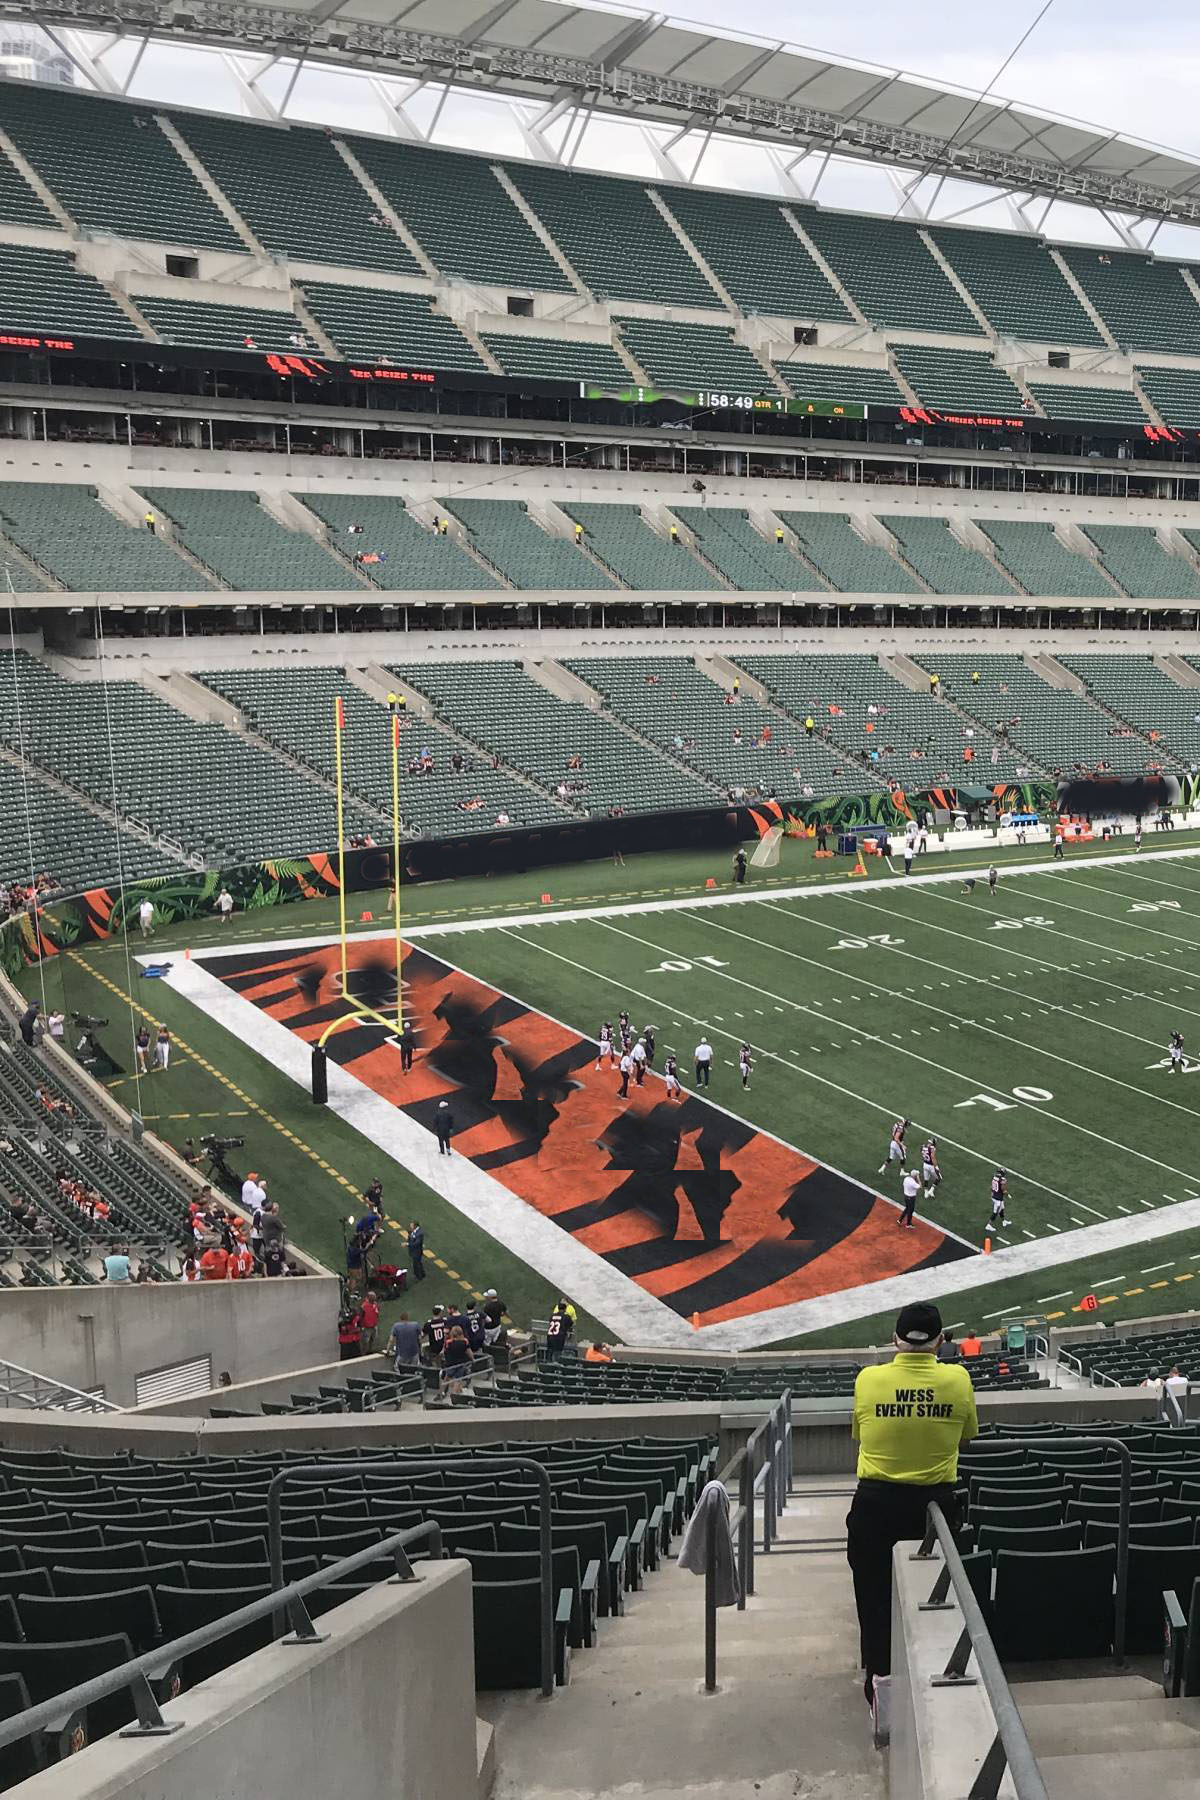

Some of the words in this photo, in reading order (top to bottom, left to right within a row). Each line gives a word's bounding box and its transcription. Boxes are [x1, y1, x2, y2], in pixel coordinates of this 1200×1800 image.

[411, 372, 435, 382] THE
[710, 394, 753, 409] 58:49
[775, 400, 782, 410] 1
[995, 916, 1055, 928] 30
[838, 934, 905, 949] 20
[660, 955, 730, 971] 10
[968, 1086, 1054, 1110] 10
[237, 1259, 246, 1271] 10
[1086, 1297, 1095, 1309] G
[470, 1320, 479, 1333] 6
[547, 1321, 561, 1335] 23
[433, 1328, 444, 1342] 10
[895, 1389, 935, 1403] WESS
[875, 1403, 914, 1418] EVENT
[916, 1403, 953, 1418] STAFF
